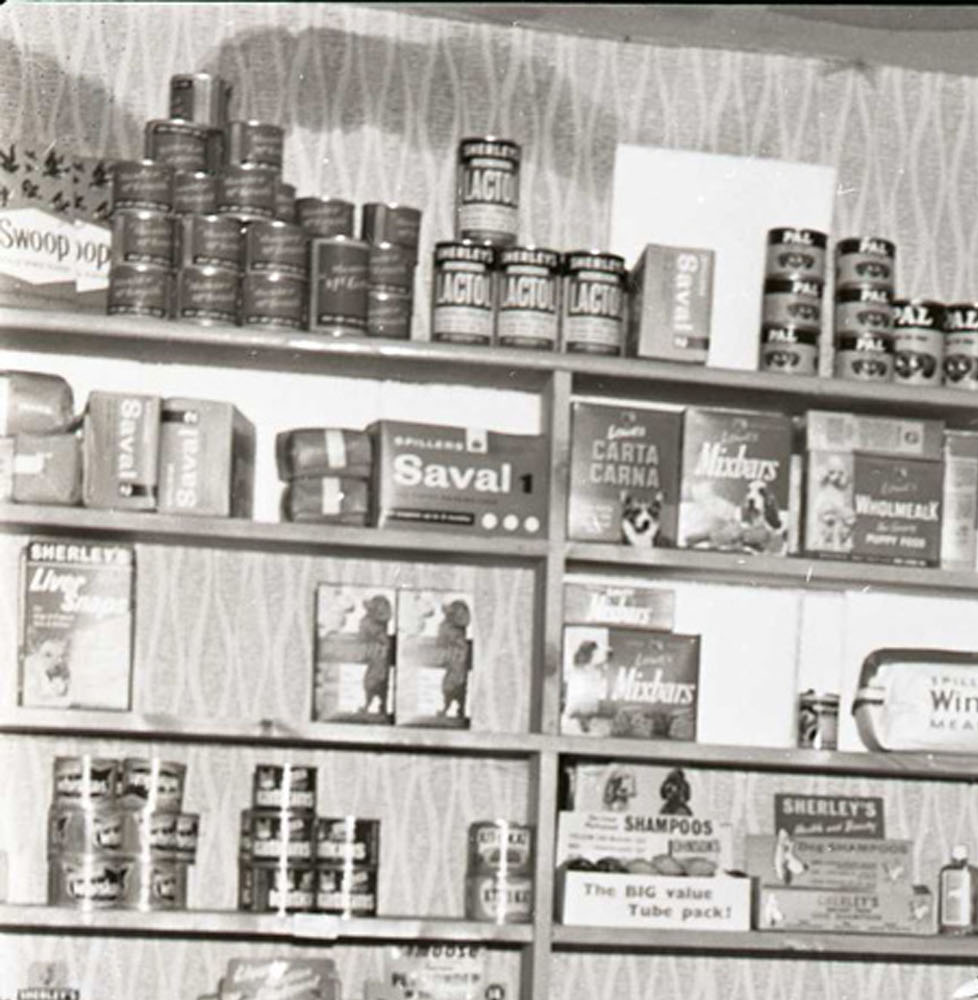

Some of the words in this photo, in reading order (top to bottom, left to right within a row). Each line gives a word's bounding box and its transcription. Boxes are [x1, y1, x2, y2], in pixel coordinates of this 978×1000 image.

[0, 218, 70, 262] Swoop
[783, 231, 814, 246] PAL
[858, 239, 888, 254] PAL
[674, 254, 699, 332] Saval
[791, 282, 820, 296] PAL
[860, 289, 888, 302] PAL
[768, 327, 799, 343] PAL
[855, 338, 886, 352] PAL
[118, 399, 142, 479] Saval
[393, 437, 464, 451] SPILLERS
[592, 440, 660, 465] CARTA
[694, 443, 781, 482] Mixbars
[175, 429, 199, 509] Saval
[393, 454, 512, 494] Saval
[519, 473, 533, 494] 1
[590, 463, 660, 488] CARNA
[30, 543, 132, 567] SHERLEY'S
[29, 567, 87, 593] Liver
[611, 666, 696, 705] Mixbars
[782, 797, 878, 818] SHERLEY'S
[624, 815, 714, 835] SHAMPOOS
[583, 882, 617, 898] The
[625, 884, 656, 899] BIG
[666, 886, 713, 901] value
[628, 903, 672, 919] Tube
[682, 906, 733, 921] pack!
